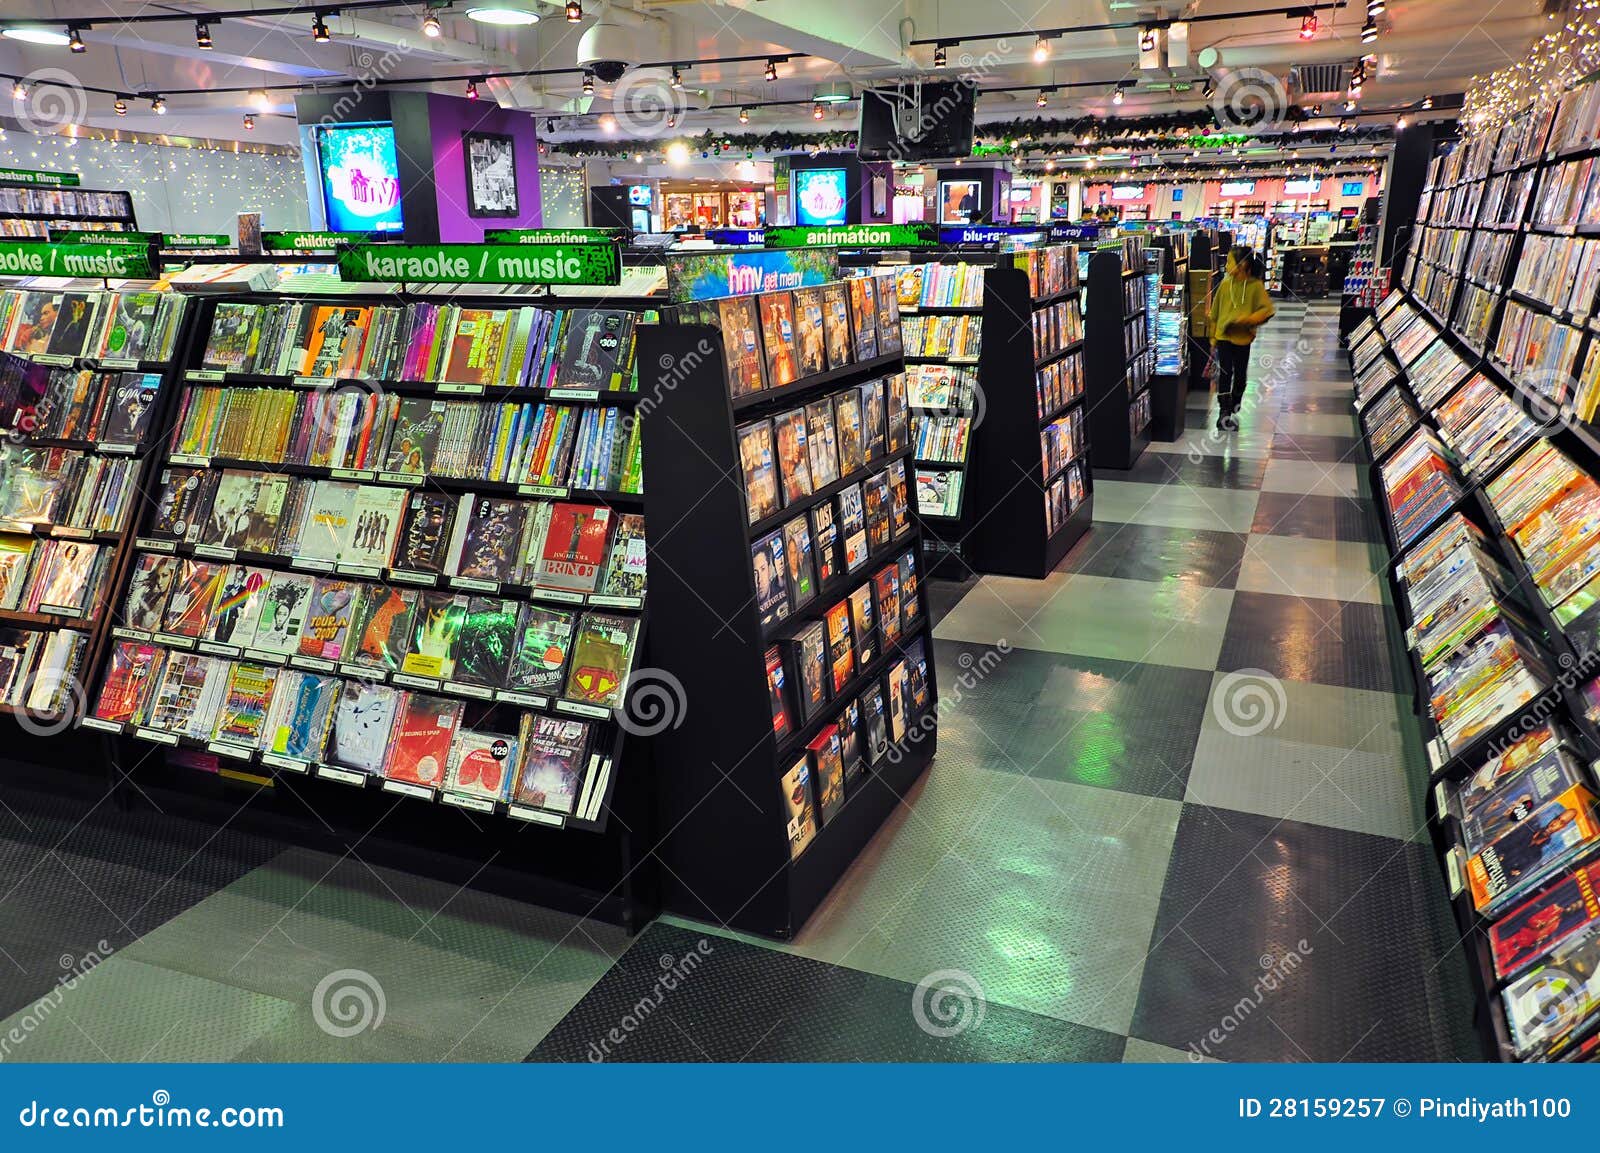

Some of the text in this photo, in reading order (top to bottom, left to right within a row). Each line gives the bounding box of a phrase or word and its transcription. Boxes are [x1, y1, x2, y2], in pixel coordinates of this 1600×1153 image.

[0, 171, 62, 184] eature films
[169, 237, 217, 245] feature films
[294, 236, 349, 248] childrens
[519, 232, 588, 243] animation
[748, 232, 765, 243] blu
[806, 228, 891, 245] animation
[963, 230, 1007, 242] blu-ra
[0, 249, 43, 272] aoke
[64, 249, 127, 275] music
[365, 251, 470, 278] karaoke
[498, 250, 582, 280] music
[764, 271, 778, 291] get
[779, 271, 804, 288] merry
[816, 502, 833, 533] LOST
[1480, 846, 1508, 893] CHAPPELLE'S
